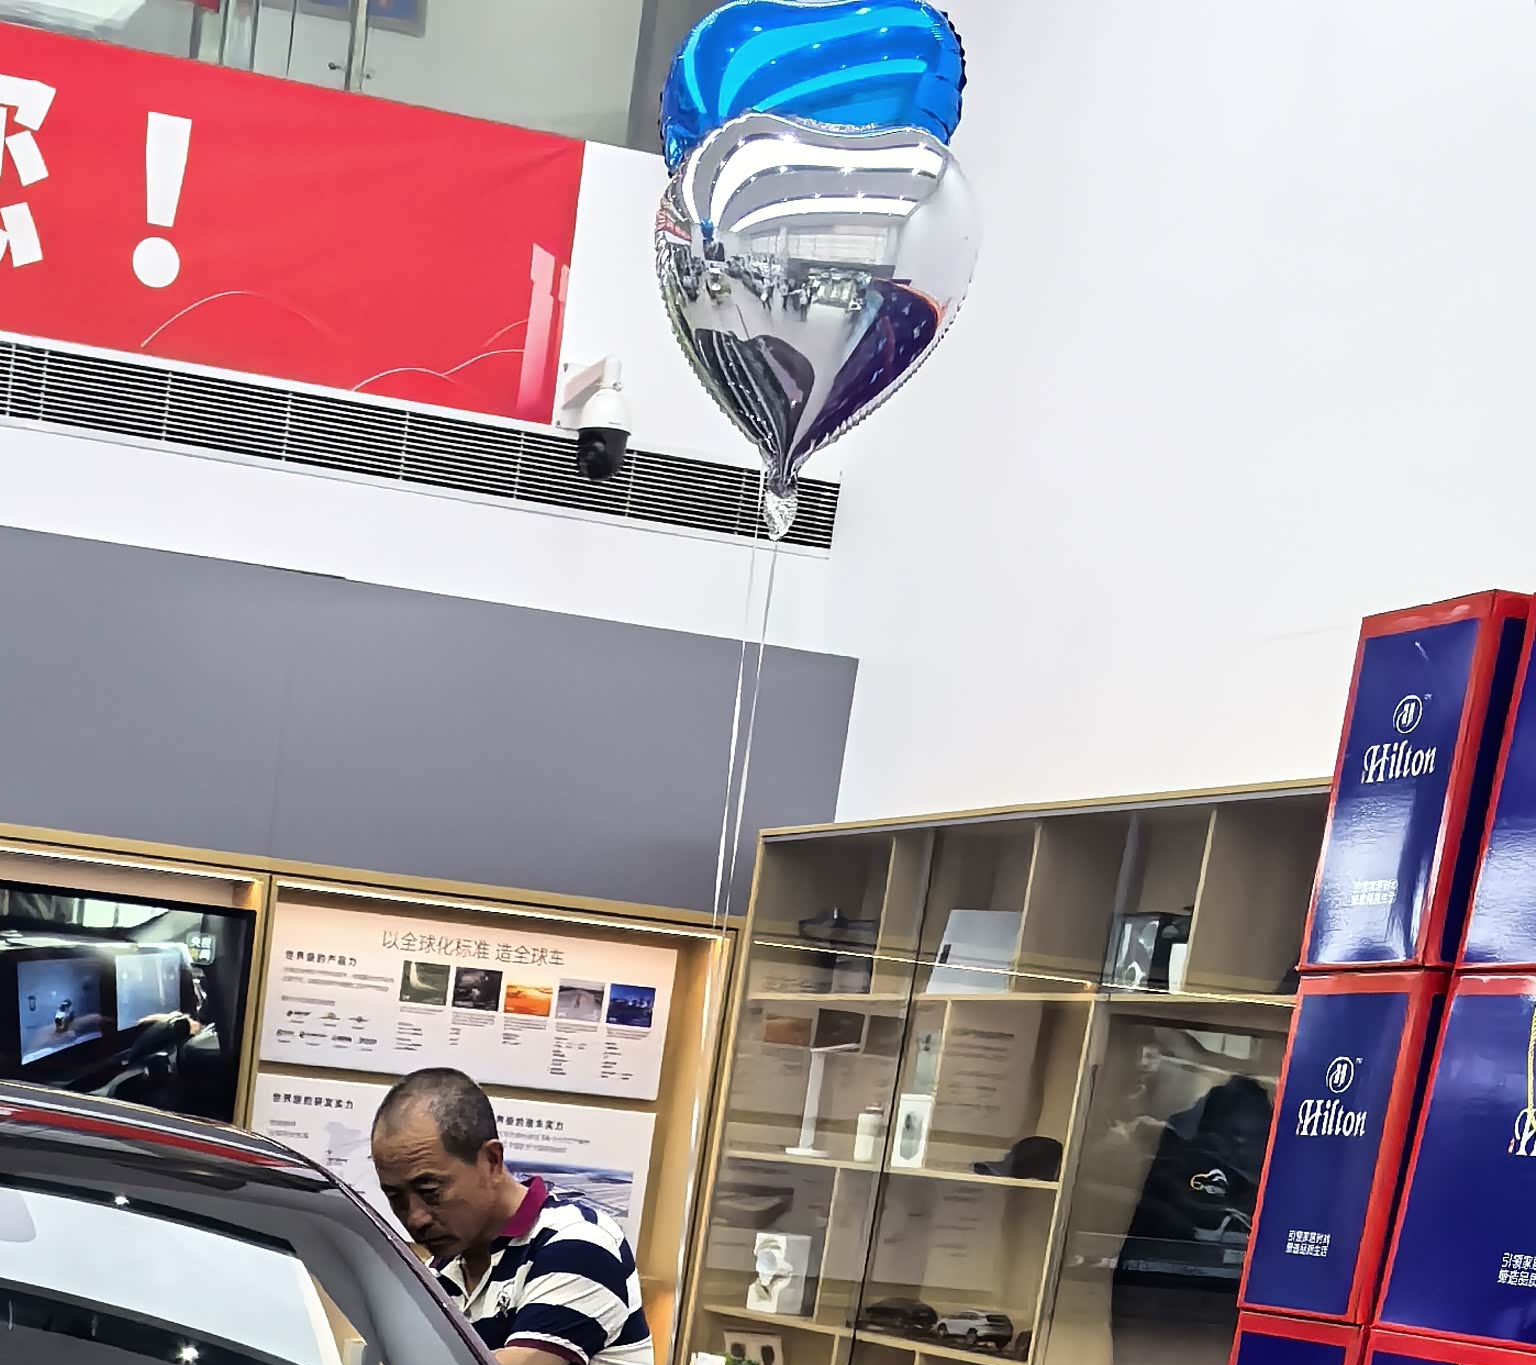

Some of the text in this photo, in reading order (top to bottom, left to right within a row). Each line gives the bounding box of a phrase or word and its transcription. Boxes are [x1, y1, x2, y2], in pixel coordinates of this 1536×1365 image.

[1361, 740, 1437, 784] Hilton
[381, 930, 566, 967] 以全球化标准 造全球车
[1296, 1098, 1368, 1137] Hilton
